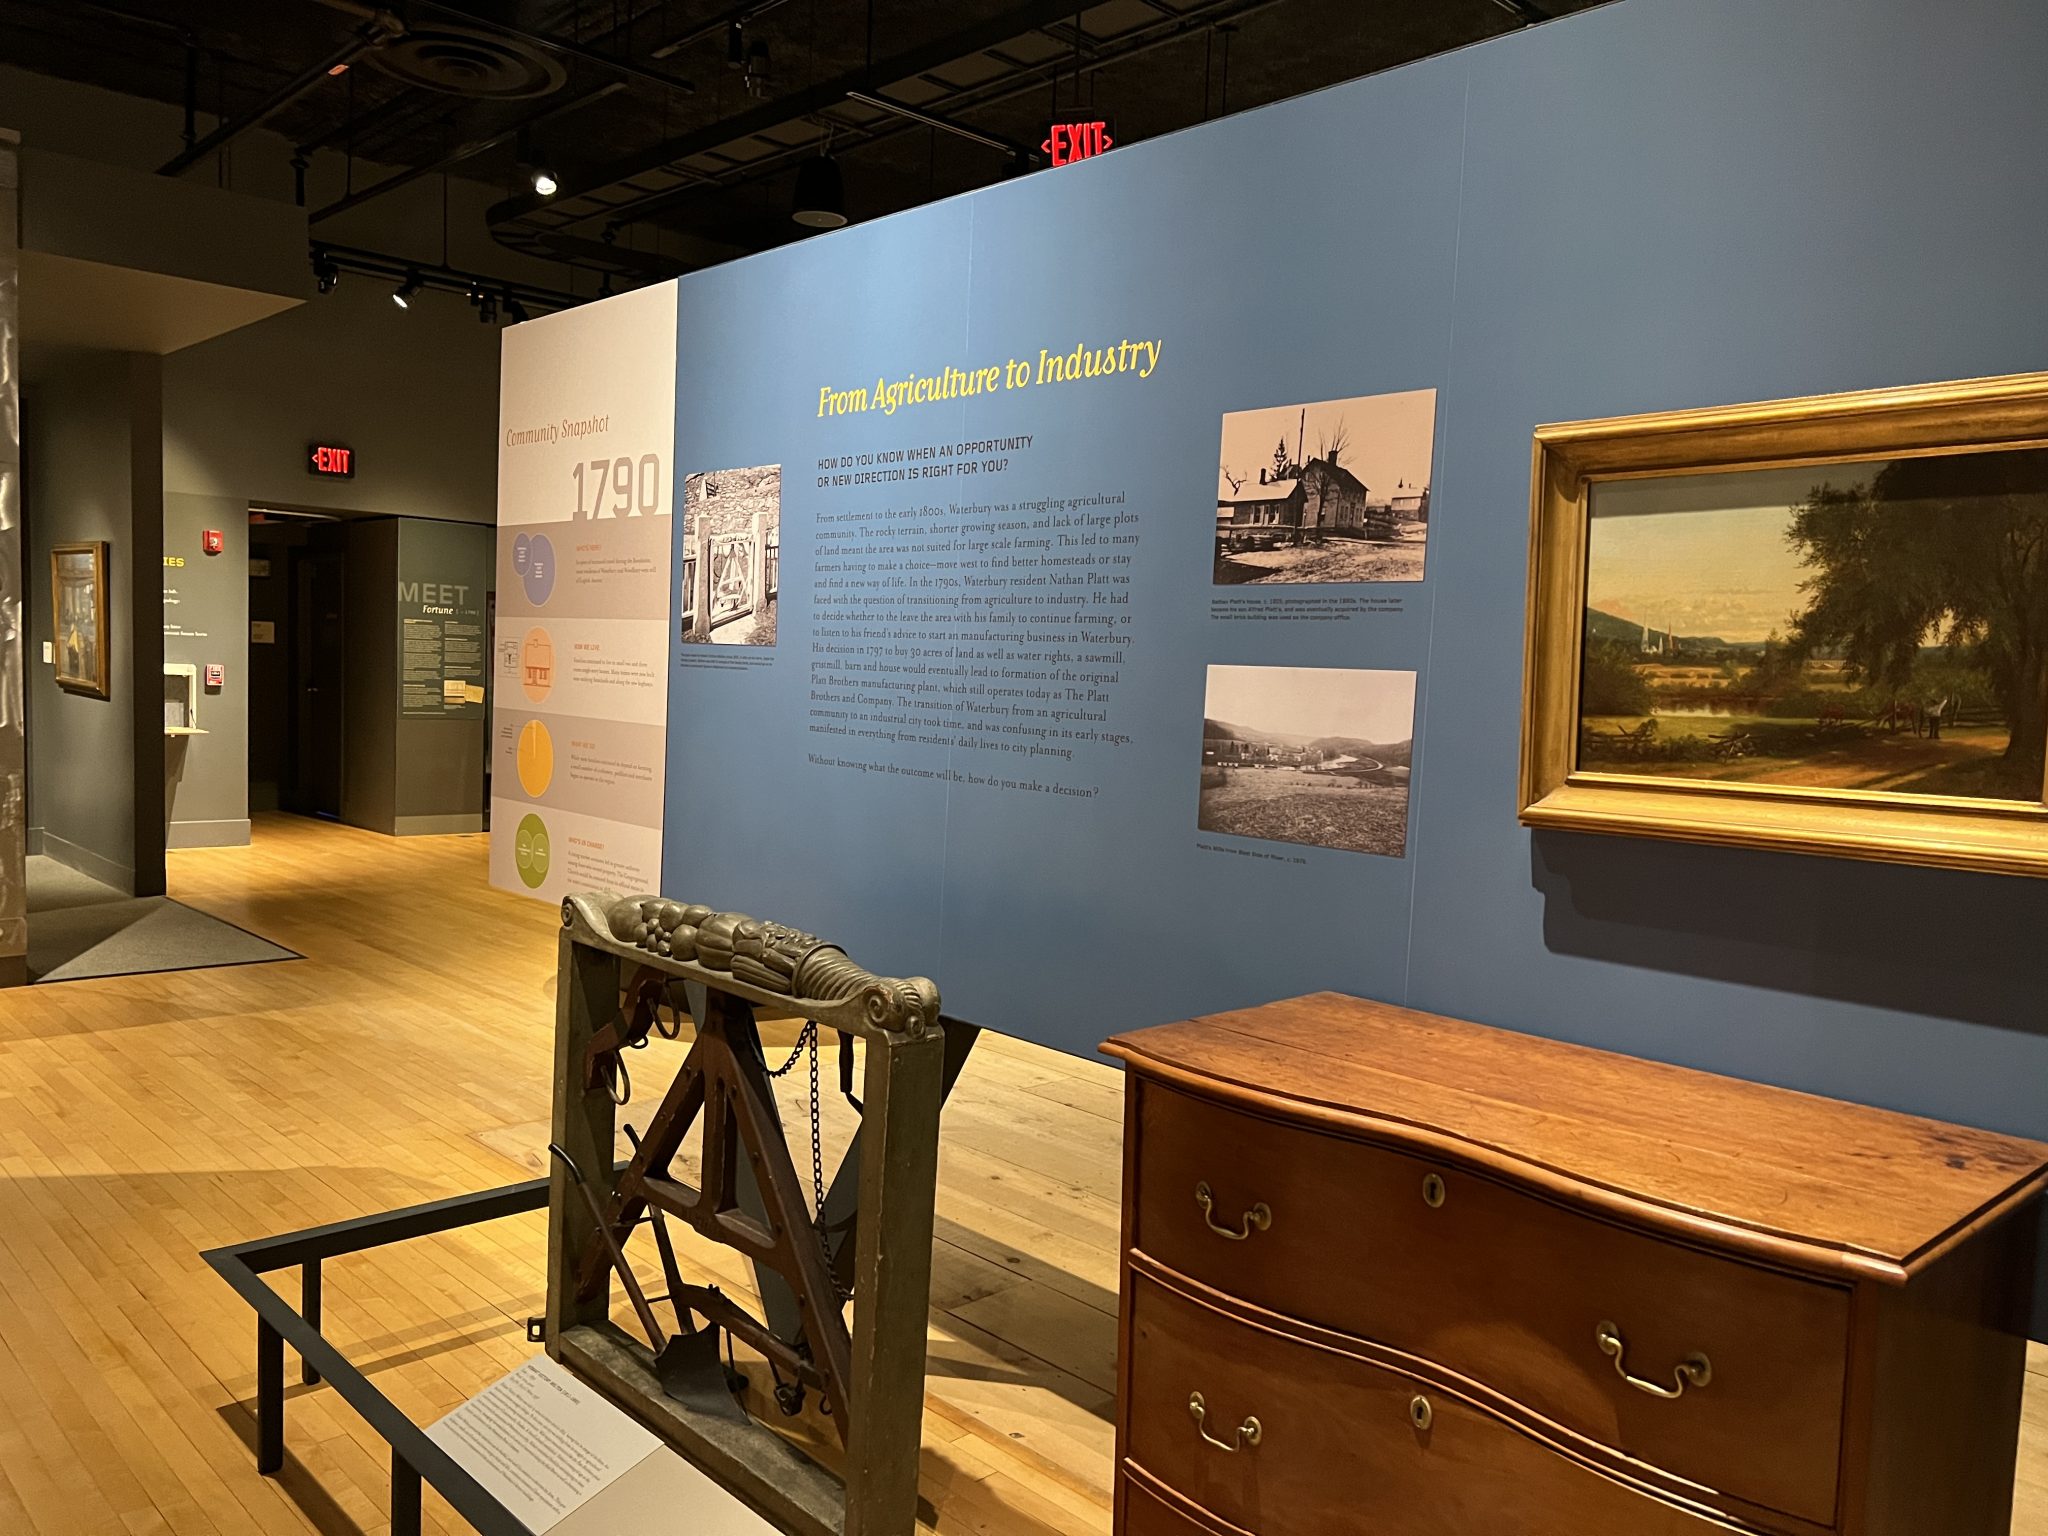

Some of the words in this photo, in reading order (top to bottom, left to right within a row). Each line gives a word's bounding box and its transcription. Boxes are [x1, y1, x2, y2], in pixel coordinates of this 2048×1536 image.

[1051, 122, 1106, 167] EXIT
[817, 386, 867, 418] From
[870, 366, 1000, 416] Agriculture
[1005, 358, 1031, 390] to
[1035, 339, 1162, 379] Industry
[506, 424, 559, 447] Community
[561, 414, 610, 440] Snapshot
[318, 446, 350, 474] EXIT
[817, 457, 838, 470] HOW
[840, 455, 853, 467] DO
[855, 453, 873, 466] YOU
[876, 450, 904, 464] KNOW
[906, 446, 936, 460] WHEN
[938, 444, 953, 457] AN
[956, 435, 1033, 455] OPPORTUNITY
[817, 476, 829, 487] OR
[831, 474, 852, 486] NEW
[854, 468, 905, 484] DIRECTION
[907, 467, 919, 479] IS
[921, 464, 953, 478] RIGHT
[956, 461, 978, 475] FOR
[981, 458, 1008, 472] YOU?
[573, 453, 660, 521] 1790
[816, 513, 834, 523] From
[898, 506, 917, 520] early
[948, 501, 991, 516] Waterbury
[1018, 496, 1065, 513] struggling
[1067, 491, 1125, 511] agricultural
[875, 525, 896, 539] rocky
[929, 522, 959, 534] shorter
[960, 520, 996, 536] growing
[997, 521, 1029, 531] season,
[1052, 514, 1071, 527] lack
[1086, 513, 1111, 529] large
[1113, 511, 1139, 528] plots
[823, 544, 839, 555] land
[840, 546, 863, 554] meant
[926, 539, 951, 551] suited
[968, 538, 989, 553] large
[990, 537, 1011, 549] scale
[1013, 536, 1053, 550] farming.
[1056, 534, 1078, 546] This
[1112, 535, 1140, 547] many
[814, 562, 841, 572] farmers
[842, 561, 867, 574] having
[877, 559, 897, 570] make
[959, 559, 978, 568] west
[991, 555, 1009, 567] find
[1011, 555, 1038, 567] better
[1040, 553, 1096, 566] homesteads
[1112, 555, 1131, 568] stay
[399, 582, 469, 605] MEET
[828, 577, 843, 588] find
[934, 579, 961, 590] 1790s,
[964, 574, 1008, 589] Waterbury
[1009, 573, 1046, 585] resident
[1048, 573, 1083, 585] Nathan
[1086, 572, 1109, 584] Platt
[423, 605, 454, 615] Fortune
[813, 594, 831, 604] faced
[832, 594, 848, 604] with
[862, 594, 895, 608] question
[906, 593, 959, 608] transitioning
[960, 593, 982, 604] from
[983, 592, 1032, 608] agriculture
[1046, 592, 1089, 608] industry.
[821, 610, 844, 620] decide
[845, 610, 875, 621] whether
[899, 610, 919, 621] leave
[934, 614, 952, 622] area
[953, 611, 972, 622] with
[988, 611, 1016, 626] family
[1029, 612, 1071, 623] continue
[1073, 611, 1117, 627] farming,
[820, 626, 840, 637] listen
[863, 627, 891, 638] friend's
[892, 628, 916, 639] advice
[928, 631, 946, 639] start
[960, 629, 1024, 645] manufacturing
[1026, 630, 1065, 642] business
[1081, 631, 1135, 648] Waterbury.
[825, 642, 855, 654] decision
[866, 647, 883, 658] 1797
[922, 649, 943, 657] acres
[954, 646, 974, 658] land
[986, 647, 1003, 659] well
[1016, 651, 1042, 660] water
[1043, 649, 1073, 665] rights,
[844, 659, 862, 671] barn
[878, 661, 901, 673] house
[902, 662, 926, 674] would
[927, 664, 969, 680] eventually
[969, 665, 988, 677] lead
[1001, 666, 1047, 679] formation
[1079, 671, 1119, 686] original
[828, 674, 859, 687] Brothers
[860, 677, 916, 694] manufacturing
[917, 680, 940, 694] plant,
[942, 681, 967, 693] which
[968, 683, 985, 694] still
[986, 687, 1024, 699] operates
[1025, 686, 1051, 702] today
[1086, 689, 1109, 702] Platt
[810, 690, 840, 702] Brothers
[913, 699, 953, 710] transition
[966, 700, 1009, 718] Waterbury
[1011, 703, 1034, 716] from
[1050, 708, 1106, 722] agricultural
[808, 723, 847, 735] manifested
[857, 728, 896, 743] everything
[897, 729, 917, 741] from
[918, 733, 956, 746] residents'
[957, 735, 978, 751] daily
[979, 737, 998, 750] lives
[1011, 741, 1027, 756] city
[809, 708, 848, 722] community
[869, 711, 907, 724] industrial
[907, 714, 922, 729] city
[923, 716, 941, 727] took
[1001, 722, 1047, 740] confusing
[1074, 728, 1099, 744] early
[808, 753, 835, 766] Without
[836, 756, 867, 773] knowing
[868, 761, 885, 772] what
[900, 767, 934, 778] outcome
[935, 769, 951, 780] will
[1018, 780, 1042, 791] make
[1052, 782, 1099, 798] decision?
